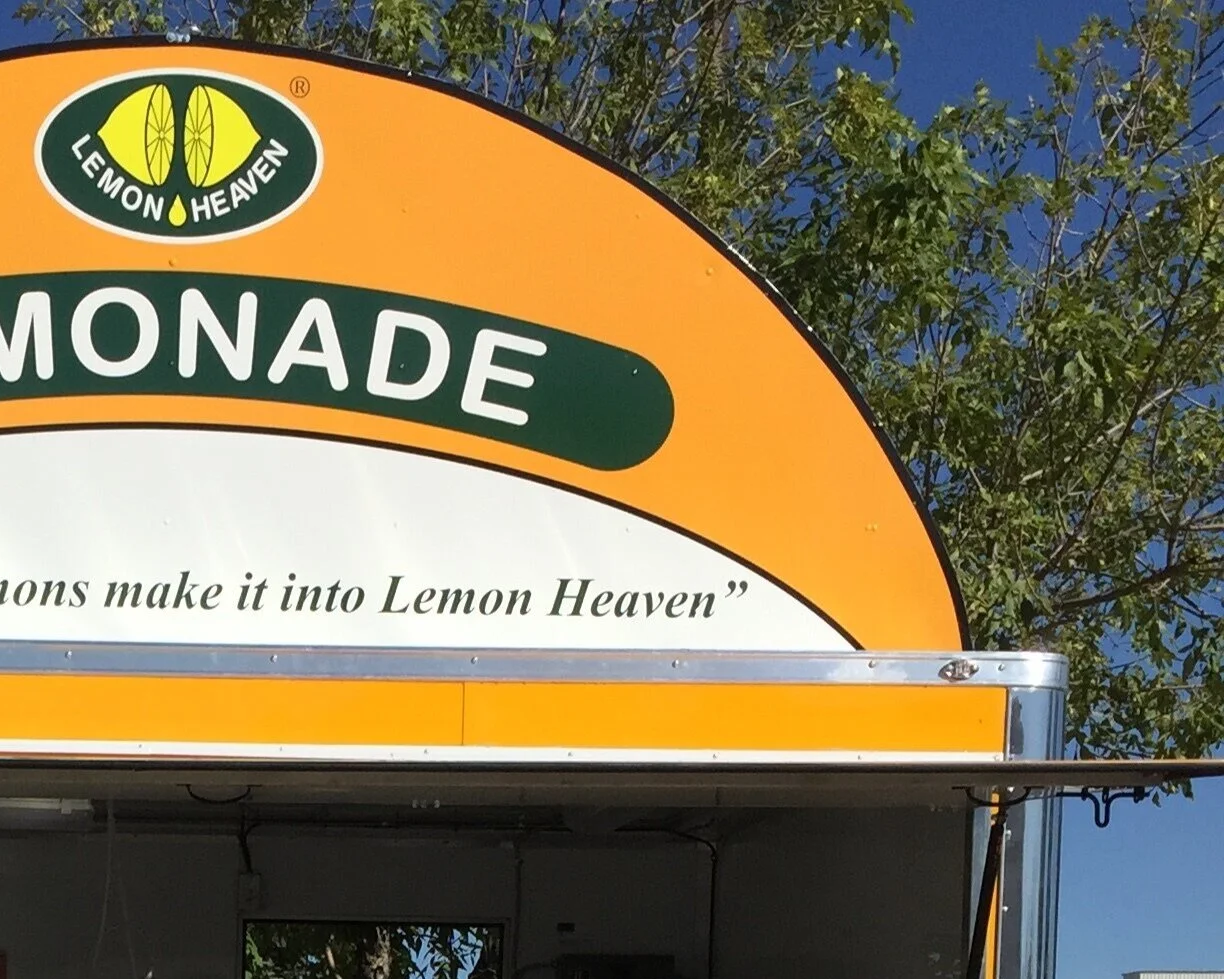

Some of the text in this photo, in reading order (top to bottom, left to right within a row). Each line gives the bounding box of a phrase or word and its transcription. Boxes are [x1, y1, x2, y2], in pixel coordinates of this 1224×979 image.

[71, 133, 289, 222] LEMON HEAVEN
[103, 571, 221, 610] make
[238, 572, 268, 611] it
[280, 573, 365, 614] into
[378, 575, 532, 616] Lemon
[547, 578, 749, 619] Heaven”
